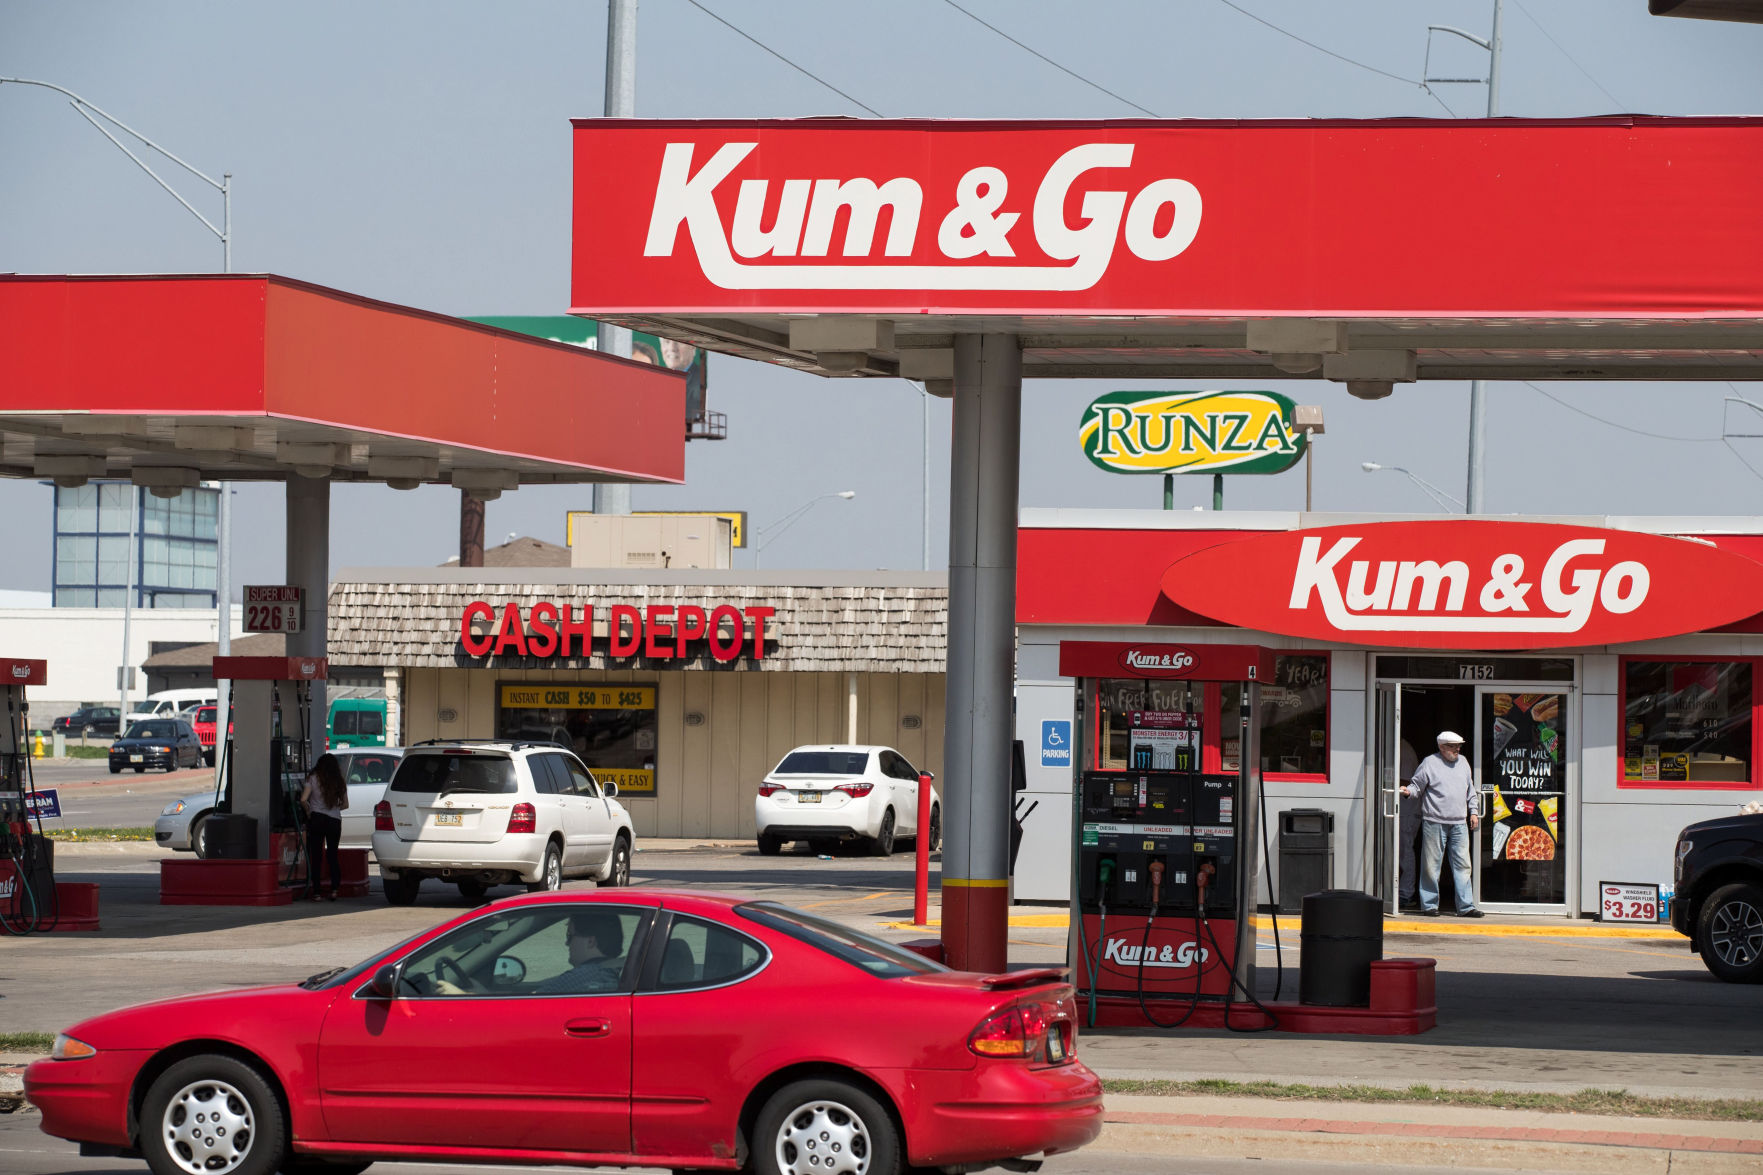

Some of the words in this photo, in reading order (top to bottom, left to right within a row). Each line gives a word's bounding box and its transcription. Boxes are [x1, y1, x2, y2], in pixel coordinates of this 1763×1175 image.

[643, 142, 923, 289] Kum
[937, 166, 1021, 259] &
[1032, 143, 1203, 291] Go
[1092, 403, 1298, 458] RUNZA
[1289, 536, 1470, 631] Kum
[1479, 553, 1533, 613] &
[1541, 538, 1650, 633] Go
[250, 587, 278, 600] SUPER
[281, 588, 297, 600] UNL
[247, 606, 282, 631] 226
[461, 601, 594, 657] CASH
[610, 604, 775, 661] DEPOT
[1126, 650, 1159, 669] Kum
[1161, 655, 1170, 666] &
[1172, 652, 1193, 669] Go
[1249, 666, 1255, 678] 4
[1461, 666, 1493, 680] 7152
[509, 692, 541, 704] INSTANT
[545, 691, 570, 705] CASH
[578, 691, 597, 706] $50
[602, 693, 611, 705] TO
[1043, 749, 1069, 758] PARKING
[1505, 748, 1527, 758] WHAT
[1500, 760, 1524, 776] YOU
[619, 775, 626, 786] &
[628, 775, 649, 787] EASY
[1510, 775, 1544, 789] TODAY?
[1604, 900, 1655, 919] $3.29
[1104, 938, 1157, 967] Kum
[1160, 945, 1174, 962] &
[1177, 941, 1209, 968] Go
